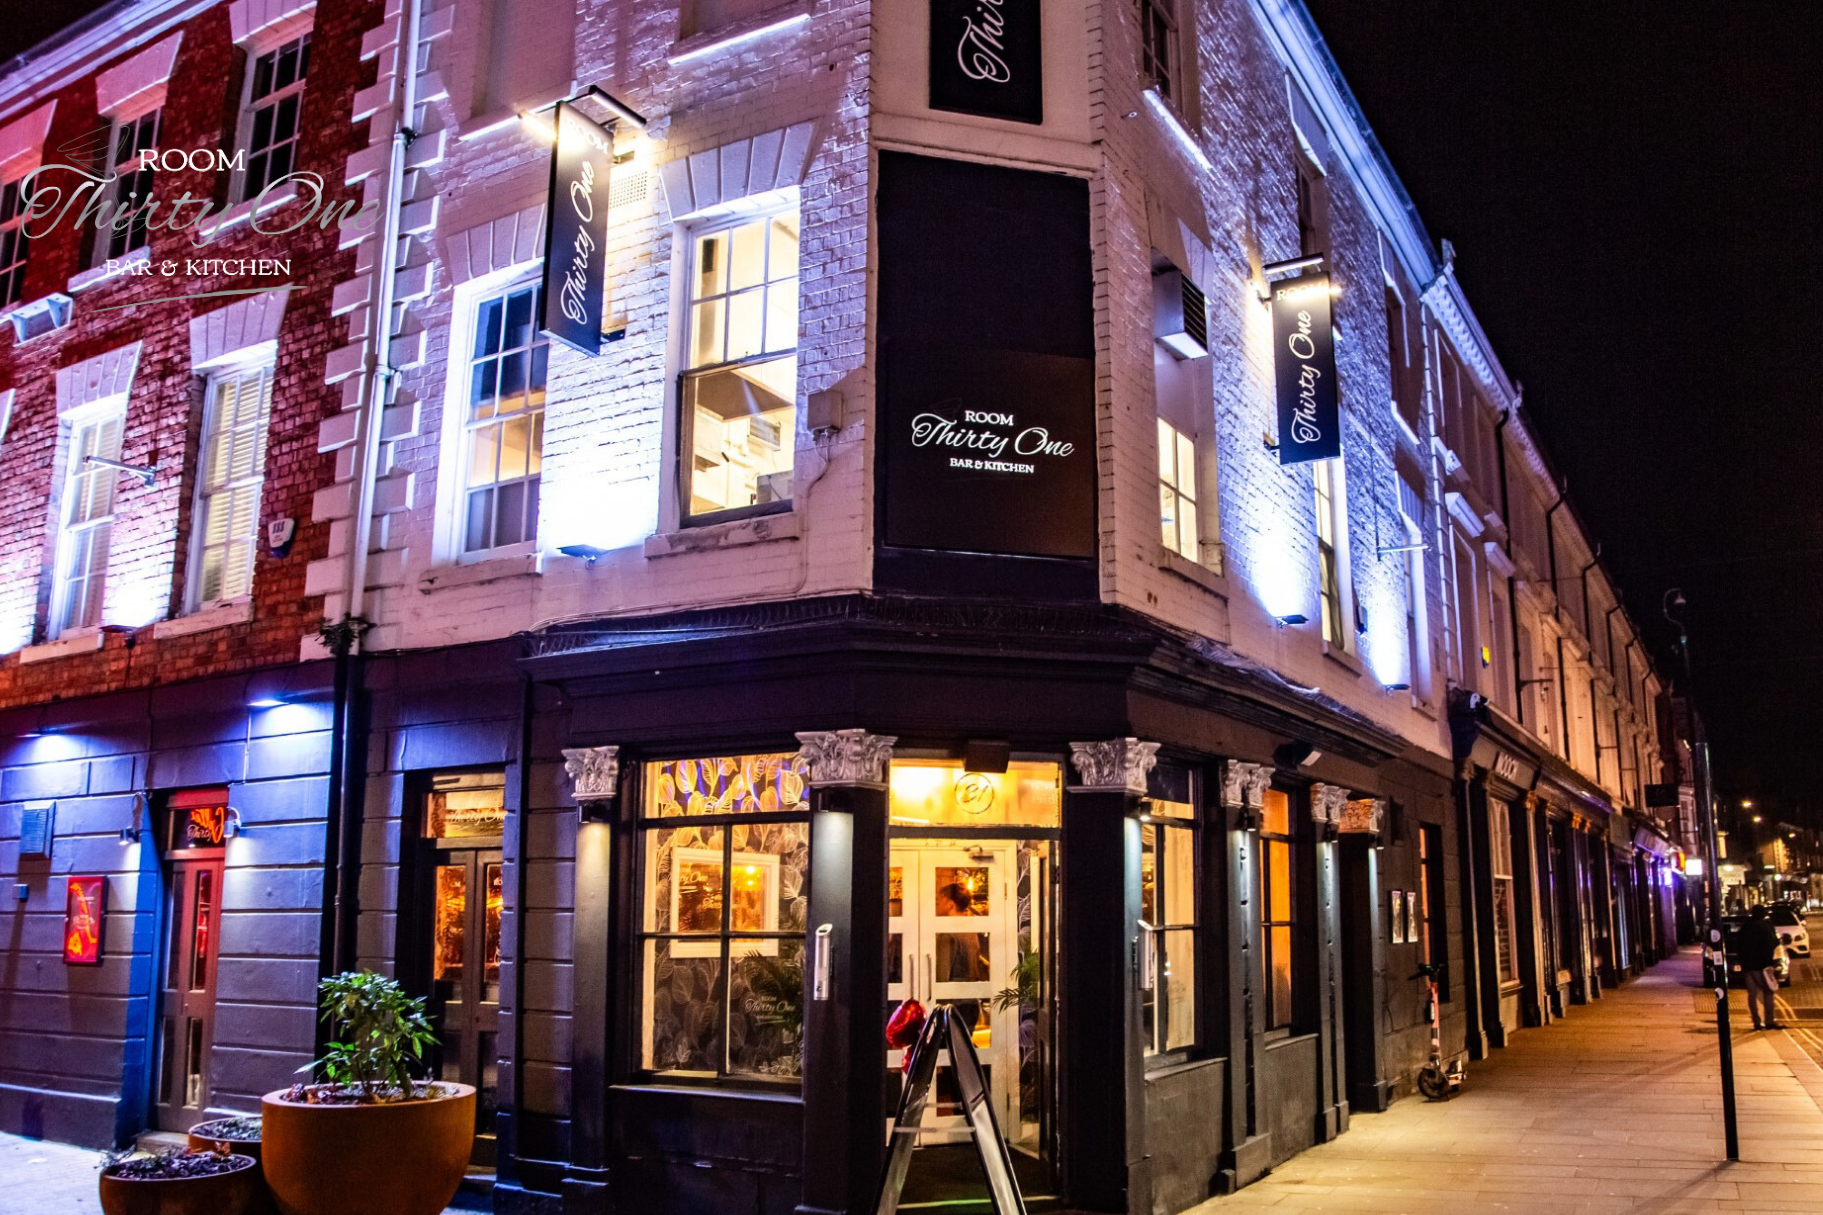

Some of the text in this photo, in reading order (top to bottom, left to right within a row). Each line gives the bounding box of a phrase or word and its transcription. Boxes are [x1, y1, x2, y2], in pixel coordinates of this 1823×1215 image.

[561, 161, 595, 325] Thirty One
[1289, 310, 1321, 443] Thirty One
[911, 413, 1075, 458] Thirty One
[965, 410, 1014, 426] ROOM
[950, 458, 1035, 473] BAR & KITCHEN
